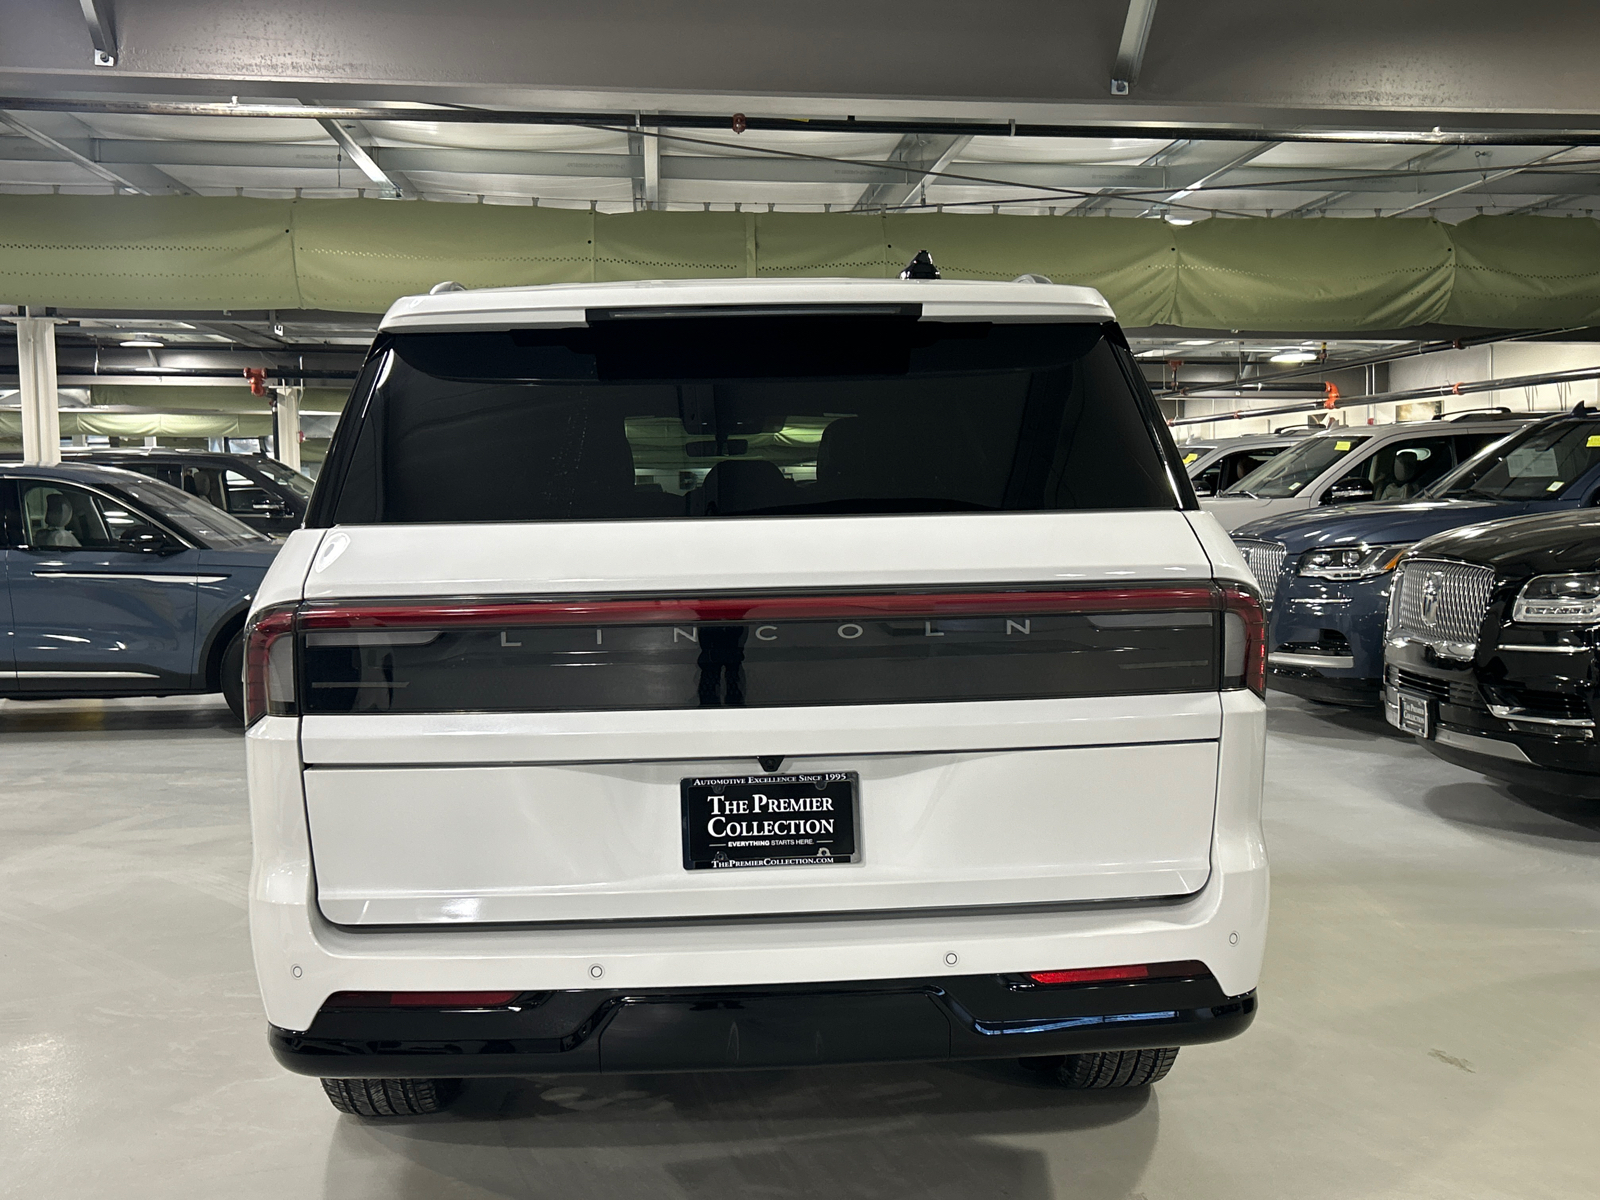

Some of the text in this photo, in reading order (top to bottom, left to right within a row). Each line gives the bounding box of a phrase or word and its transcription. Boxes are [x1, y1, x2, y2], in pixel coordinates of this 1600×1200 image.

[500, 619, 1031, 648] LINCOLN
[693, 773, 847, 786] AUTOMOTIVE EXCELLENCE SINCE 1995
[707, 794, 834, 815] THE PREMIER
[707, 816, 835, 838] COLLECTION
[728, 840, 770, 848] EVERYTHING
